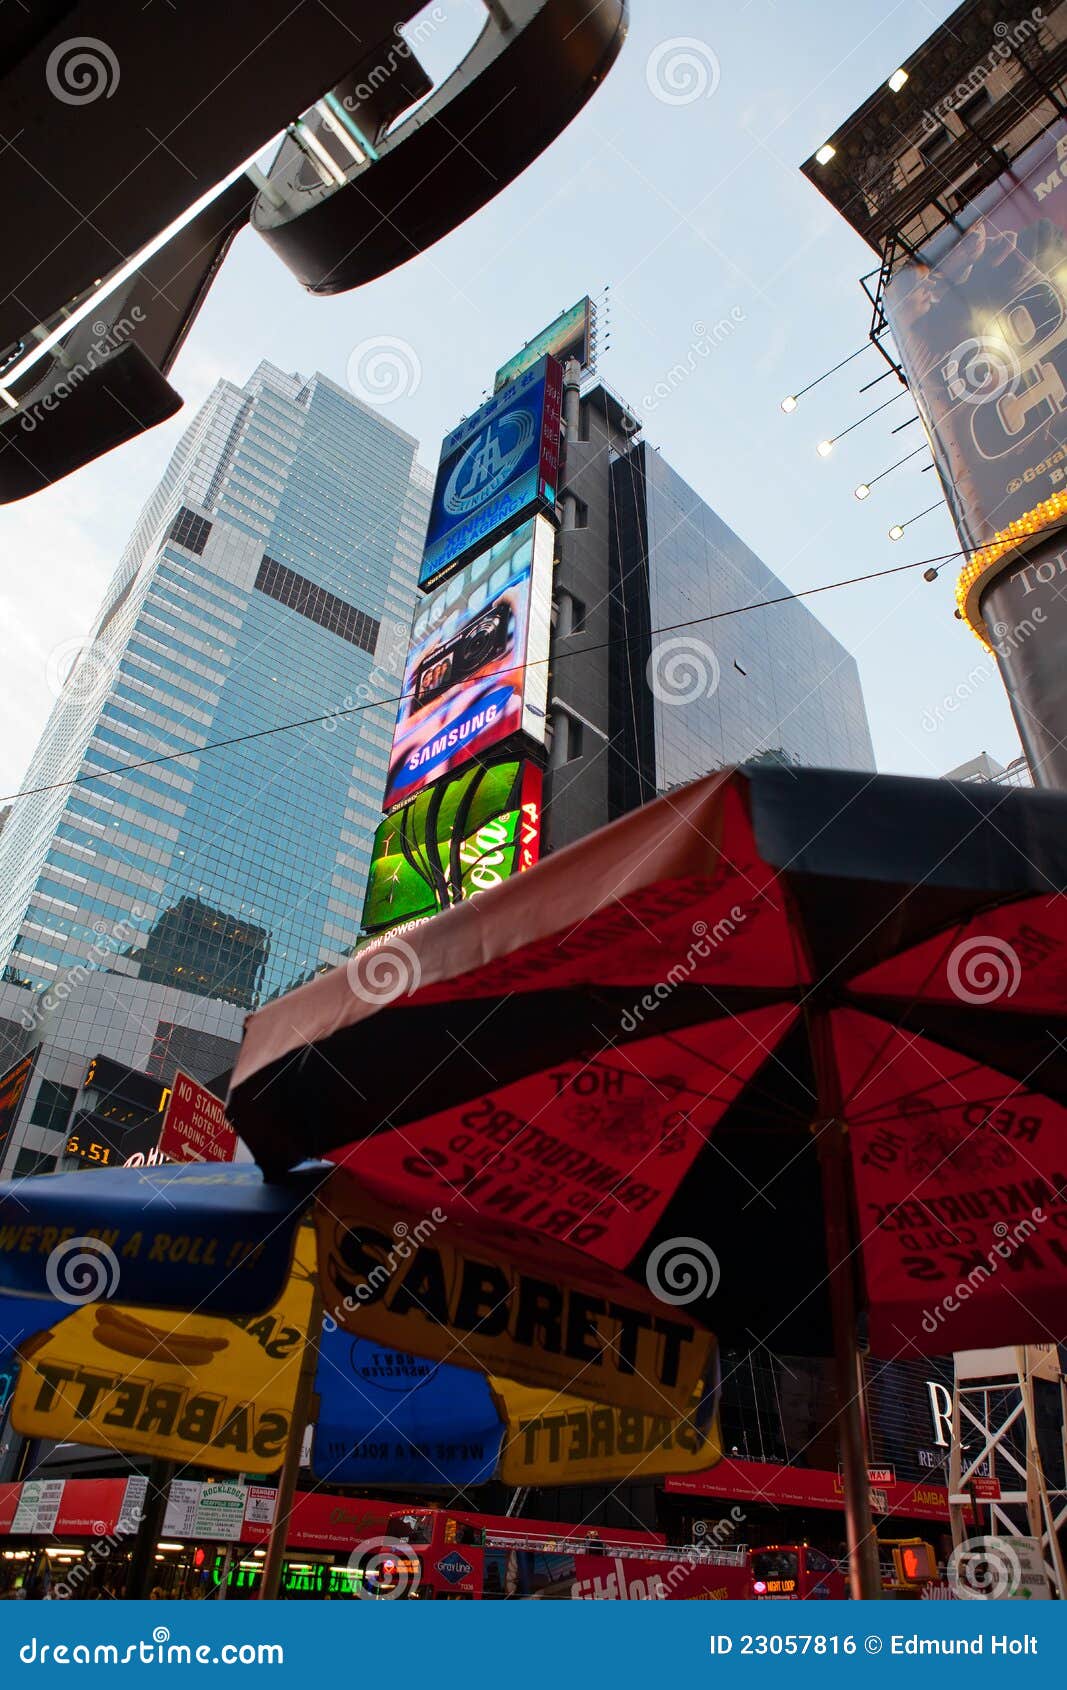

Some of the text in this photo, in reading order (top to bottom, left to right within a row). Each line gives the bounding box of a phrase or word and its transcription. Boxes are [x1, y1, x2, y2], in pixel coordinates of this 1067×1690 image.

[408, 704, 499, 771] SAMSUNG
[178, 1081, 193, 1103] NO
[173, 1117, 206, 1147] LOADING
[208, 1140, 228, 1162] ZONE
[191, 1112, 217, 1140] HOTEL
[148, 1233, 218, 1266] ROLL
[327, 1224, 696, 1389] SABRETT
[912, 1489, 946, 1506] JAMBA
